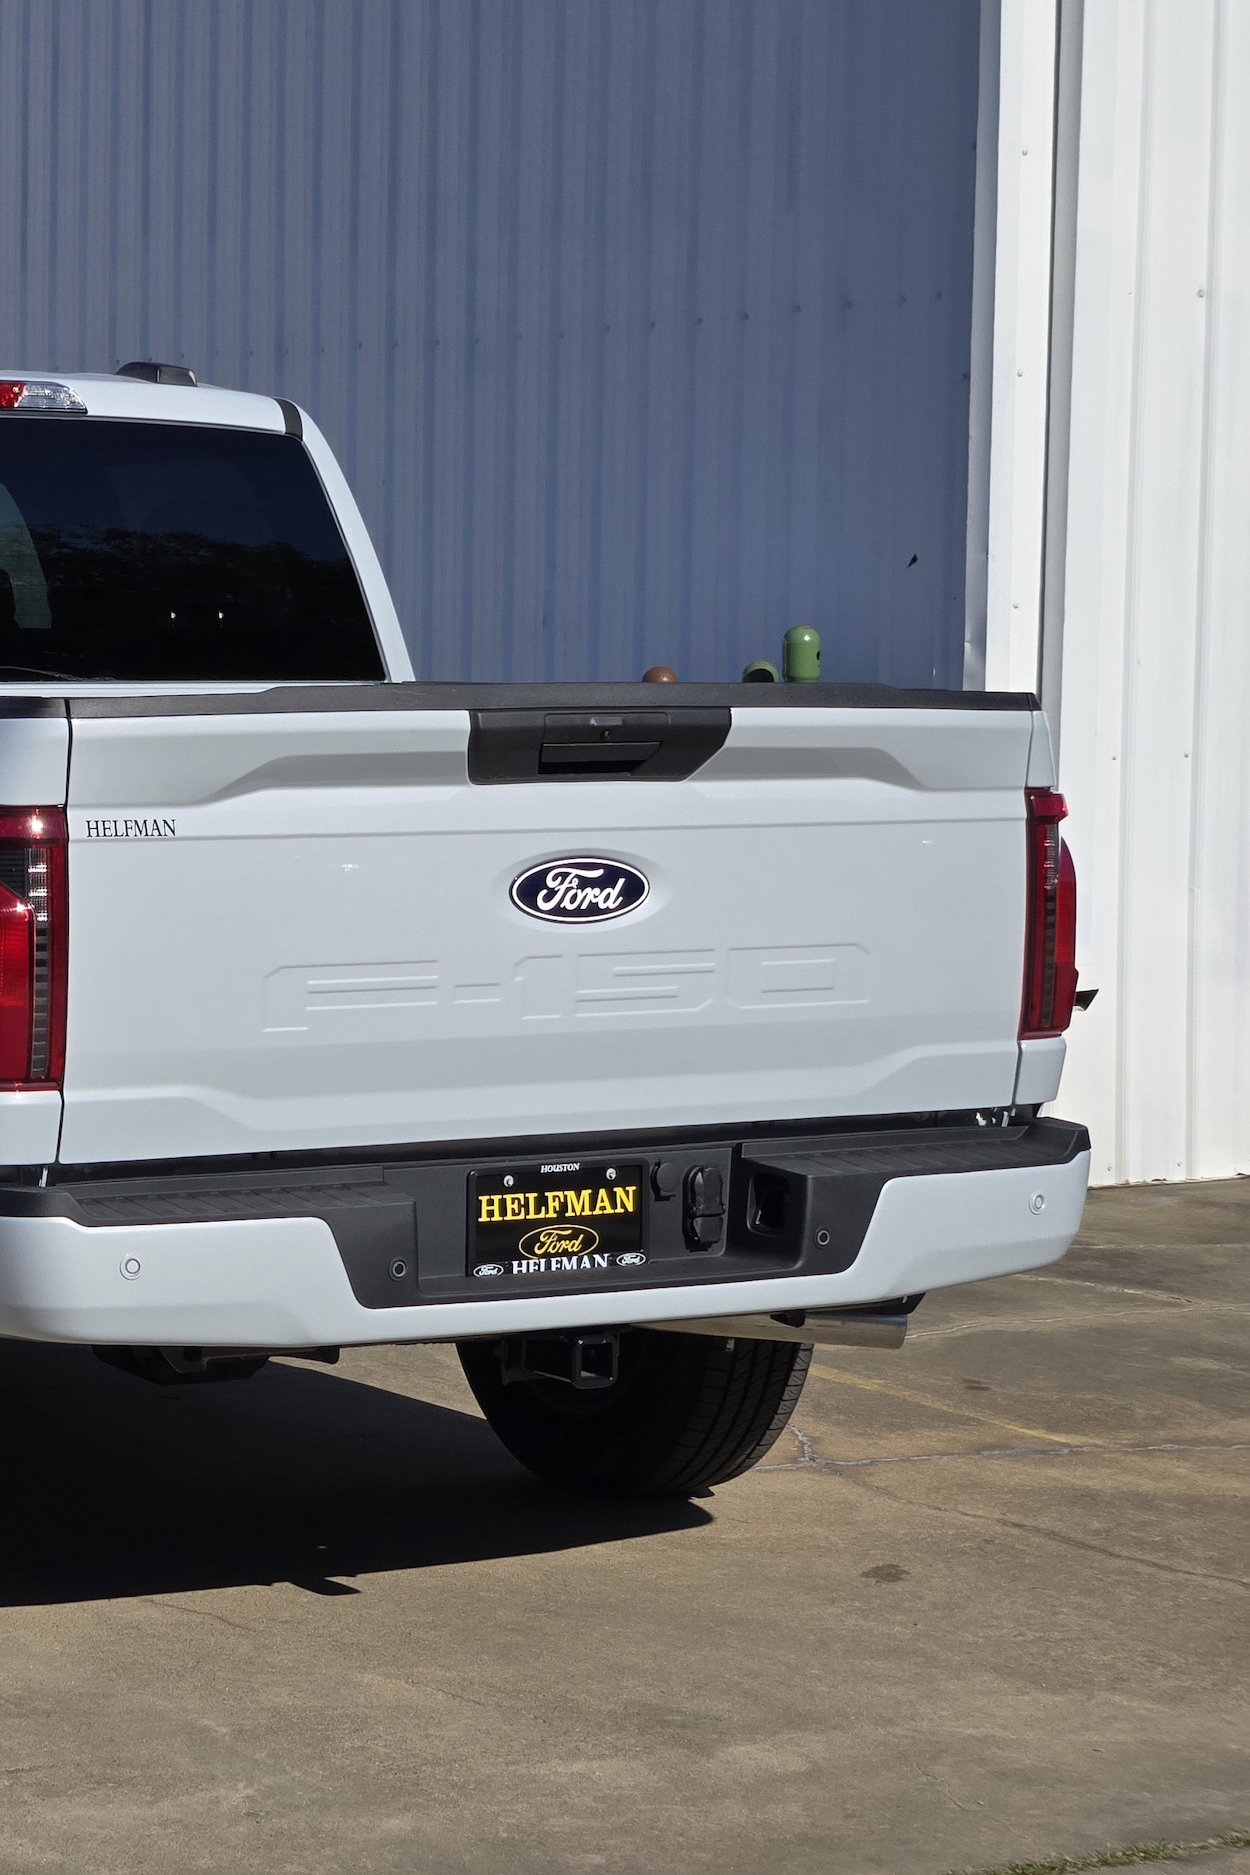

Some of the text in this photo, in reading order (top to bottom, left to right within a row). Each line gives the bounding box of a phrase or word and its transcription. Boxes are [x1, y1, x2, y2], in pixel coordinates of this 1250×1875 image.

[85, 819, 176, 838] HELFMAN
[536, 867, 626, 911] Ford
[540, 1163, 581, 1174] HOUSTON
[478, 1186, 637, 1222] HELFMAN
[534, 1229, 585, 1255] Ford
[620, 1253, 641, 1265] Ford
